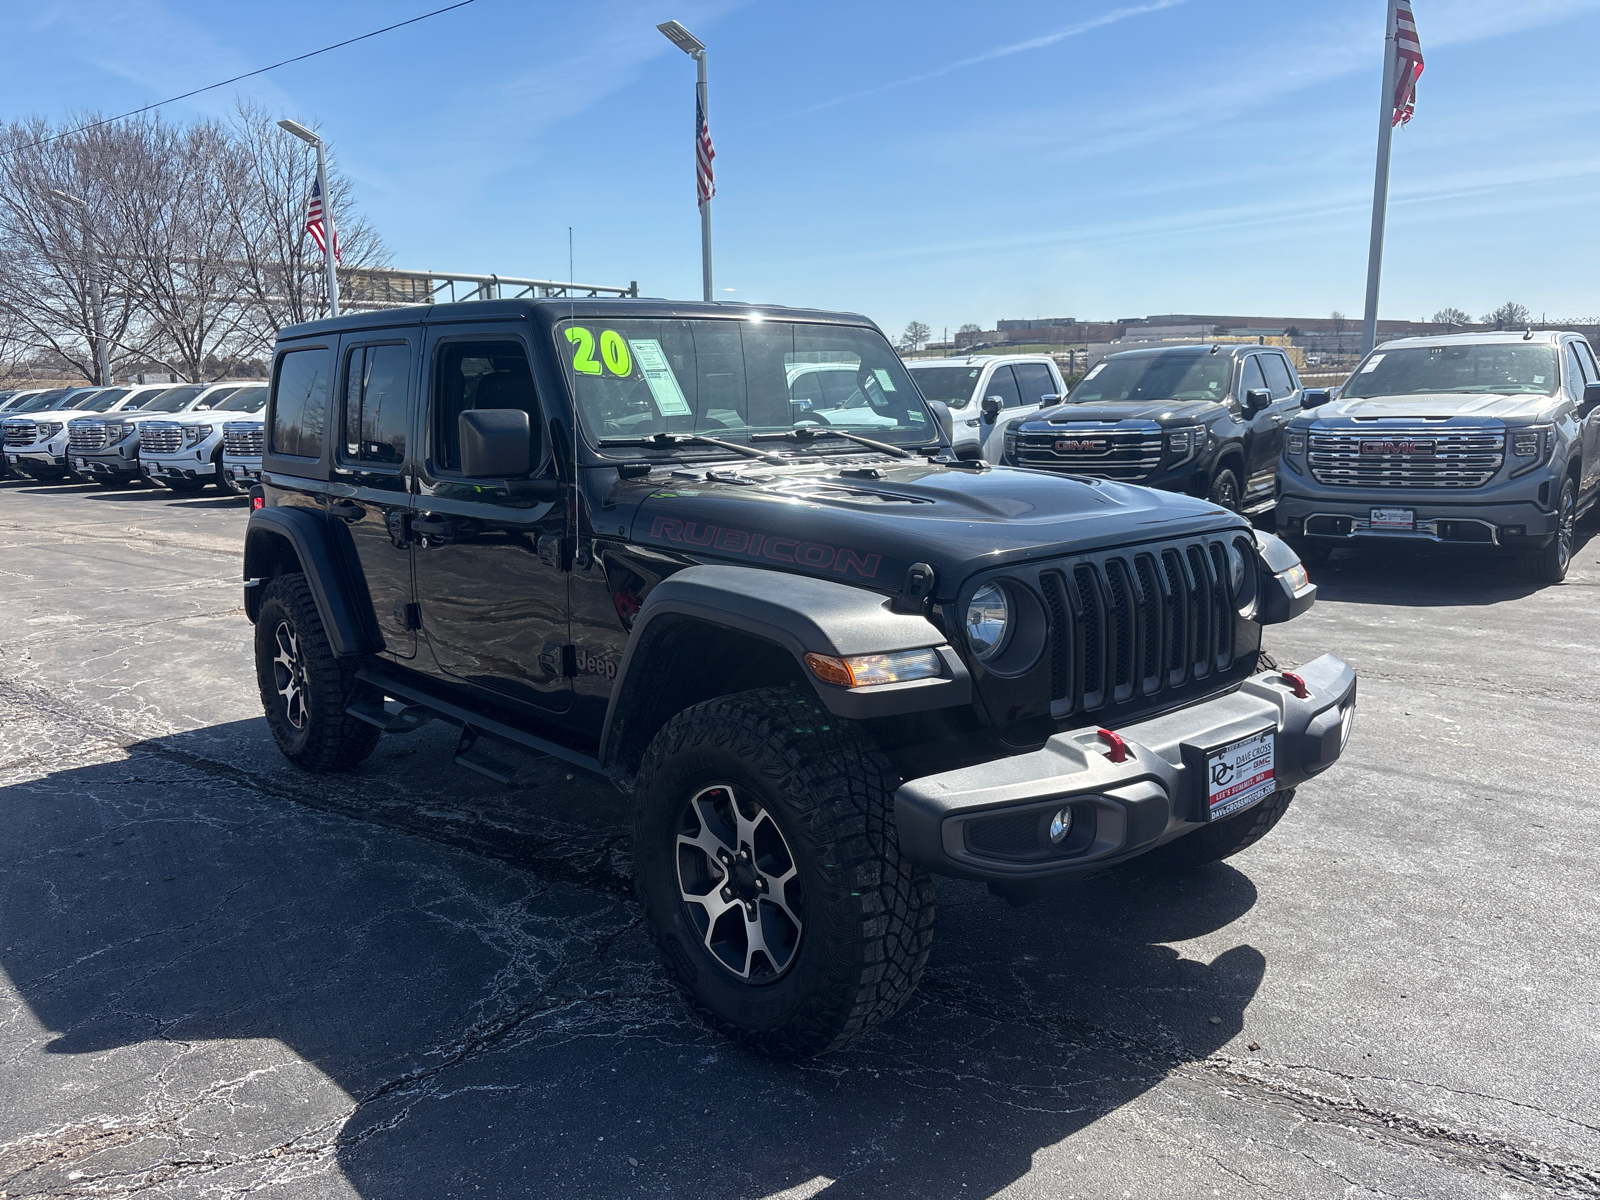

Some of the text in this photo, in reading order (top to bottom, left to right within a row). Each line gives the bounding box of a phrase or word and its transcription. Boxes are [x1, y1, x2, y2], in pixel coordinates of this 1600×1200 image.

[564, 326, 633, 378] 20
[1055, 439, 1107, 451] GMC
[1362, 441, 1433, 454] GMC
[650, 516, 882, 578] RUBICON
[576, 649, 617, 681] Jeep
[1236, 751, 1252, 765] DAVE
[1252, 742, 1271, 757] CROSS
[1253, 756, 1271, 768] GMC
[1216, 790, 1231, 801] LEE'S
[1255, 773, 1265, 783] MO
